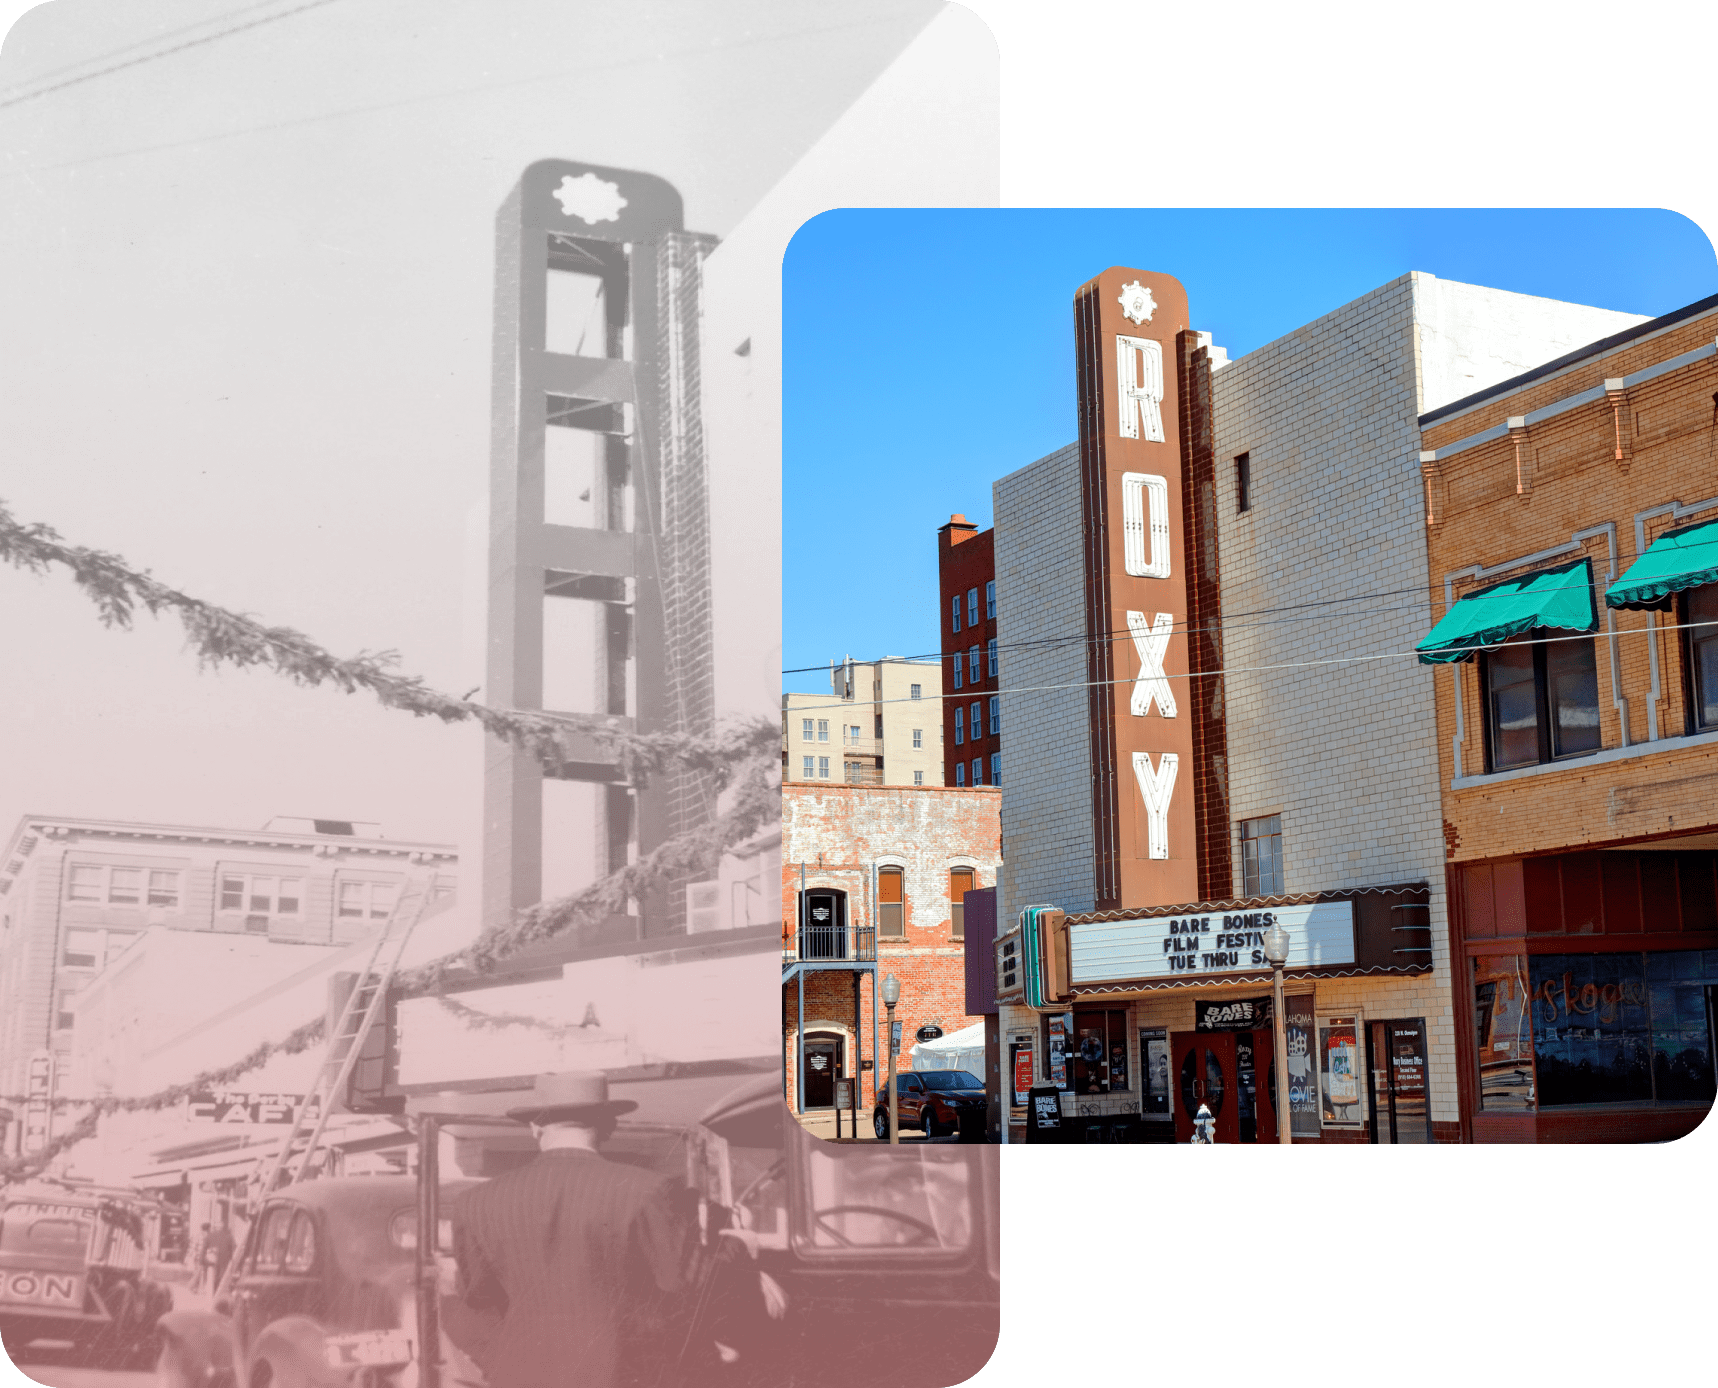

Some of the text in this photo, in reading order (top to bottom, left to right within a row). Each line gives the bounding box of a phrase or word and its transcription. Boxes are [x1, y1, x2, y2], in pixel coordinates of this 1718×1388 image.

[1116, 334, 1178, 860] ROXY
[1170, 912, 1273, 934] BARE BONES
[1164, 931, 1267, 953] FILM FESTIV
[1169, 954, 1196, 970] TUE
[1202, 951, 1239, 967] THRU
[1204, 1011, 1253, 1023] BONES
[1206, 1002, 1253, 1016] BARE
[1285, 1013, 1312, 1024] LAHOMA
[1034, 1096, 1056, 1105] BARE
[1289, 1086, 1316, 1103] OVIE
[189, 1102, 318, 1129] CAFE
[1035, 1104, 1058, 1113] BONES
[1293, 1104, 1301, 1112] OF
[1301, 1104, 1316, 1112] FAME
[0, 1272, 75, 1299] ON
